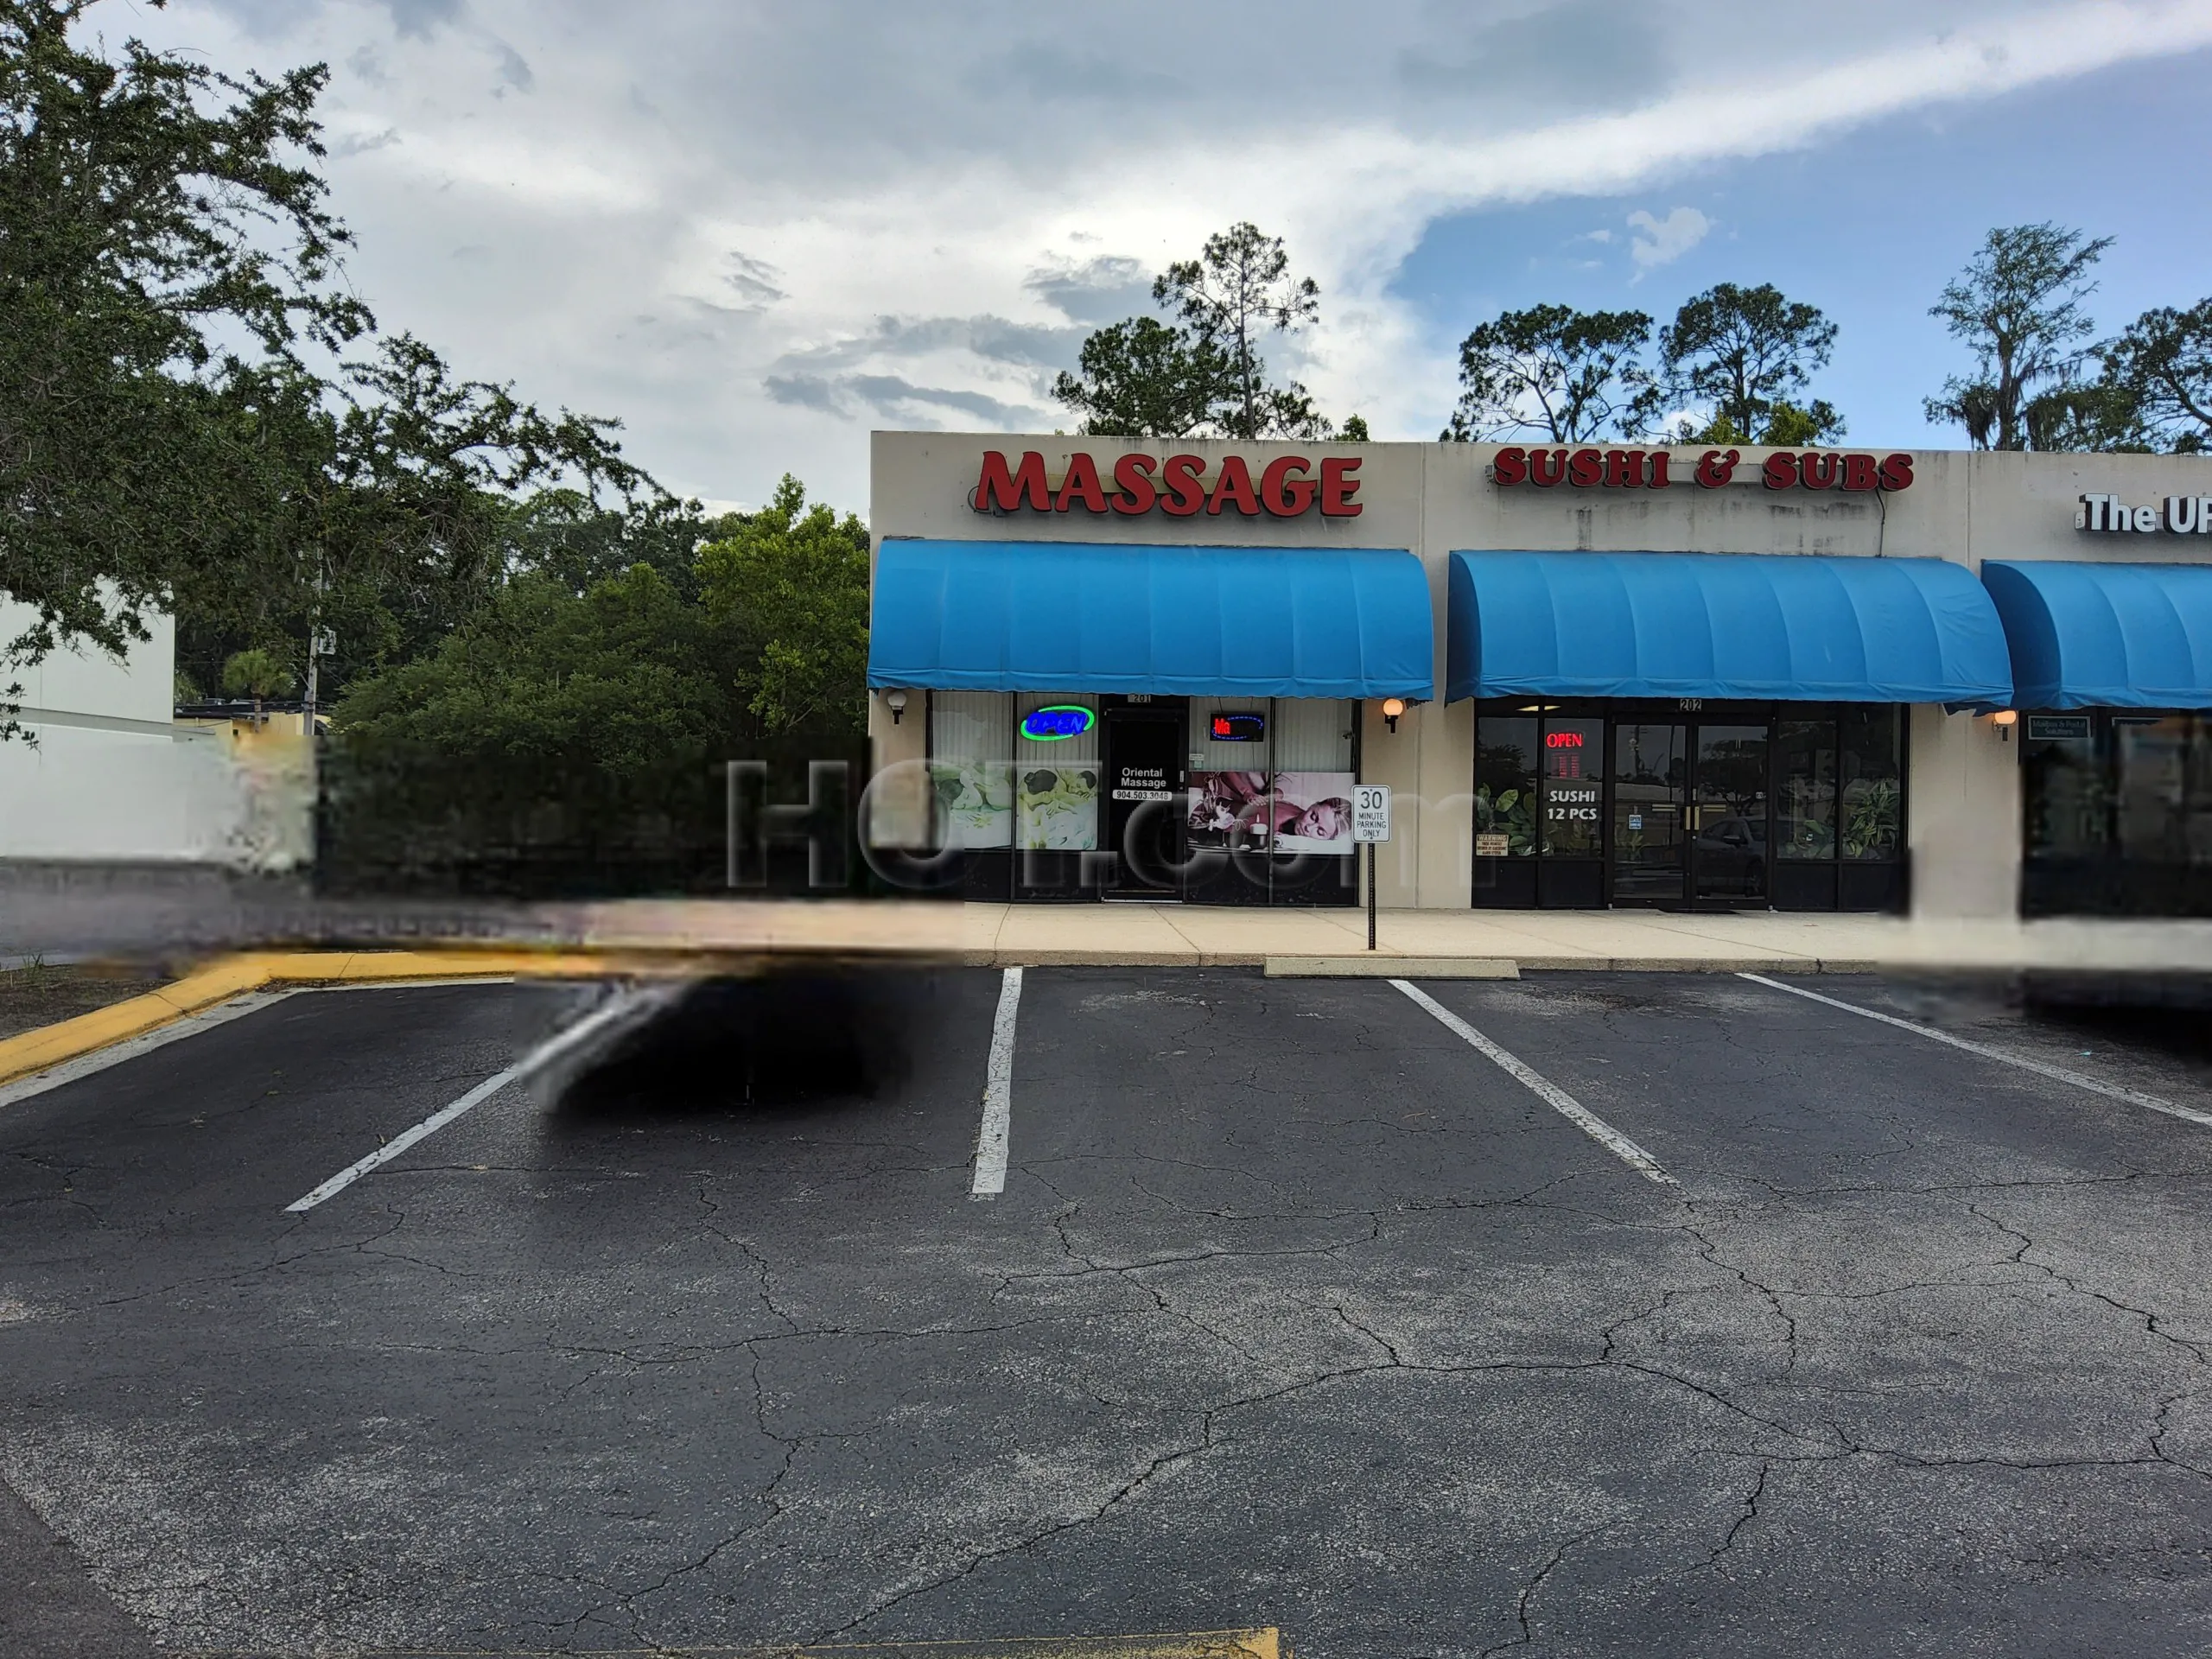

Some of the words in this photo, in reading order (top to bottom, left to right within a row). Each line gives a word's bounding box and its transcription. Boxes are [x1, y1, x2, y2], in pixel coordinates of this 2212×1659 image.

[1492, 447, 1672, 489] SUSHI
[1694, 448, 1741, 490] &
[1761, 450, 1915, 492] SUBS
[975, 450, 1363, 517] MASSAGE
[2079, 493, 2158, 533] The
[1681, 699, 1701, 711] 202
[1026, 711, 1088, 735] OPEN
[1547, 733, 1583, 748] OPEN
[1122, 767, 1163, 778] Oriental
[1121, 778, 1166, 790] Massage
[1361, 791, 1382, 809] 30
[1549, 791, 1595, 802] SUSHI
[1548, 808, 1565, 820] 12
[1569, 808, 1597, 820] PCS
